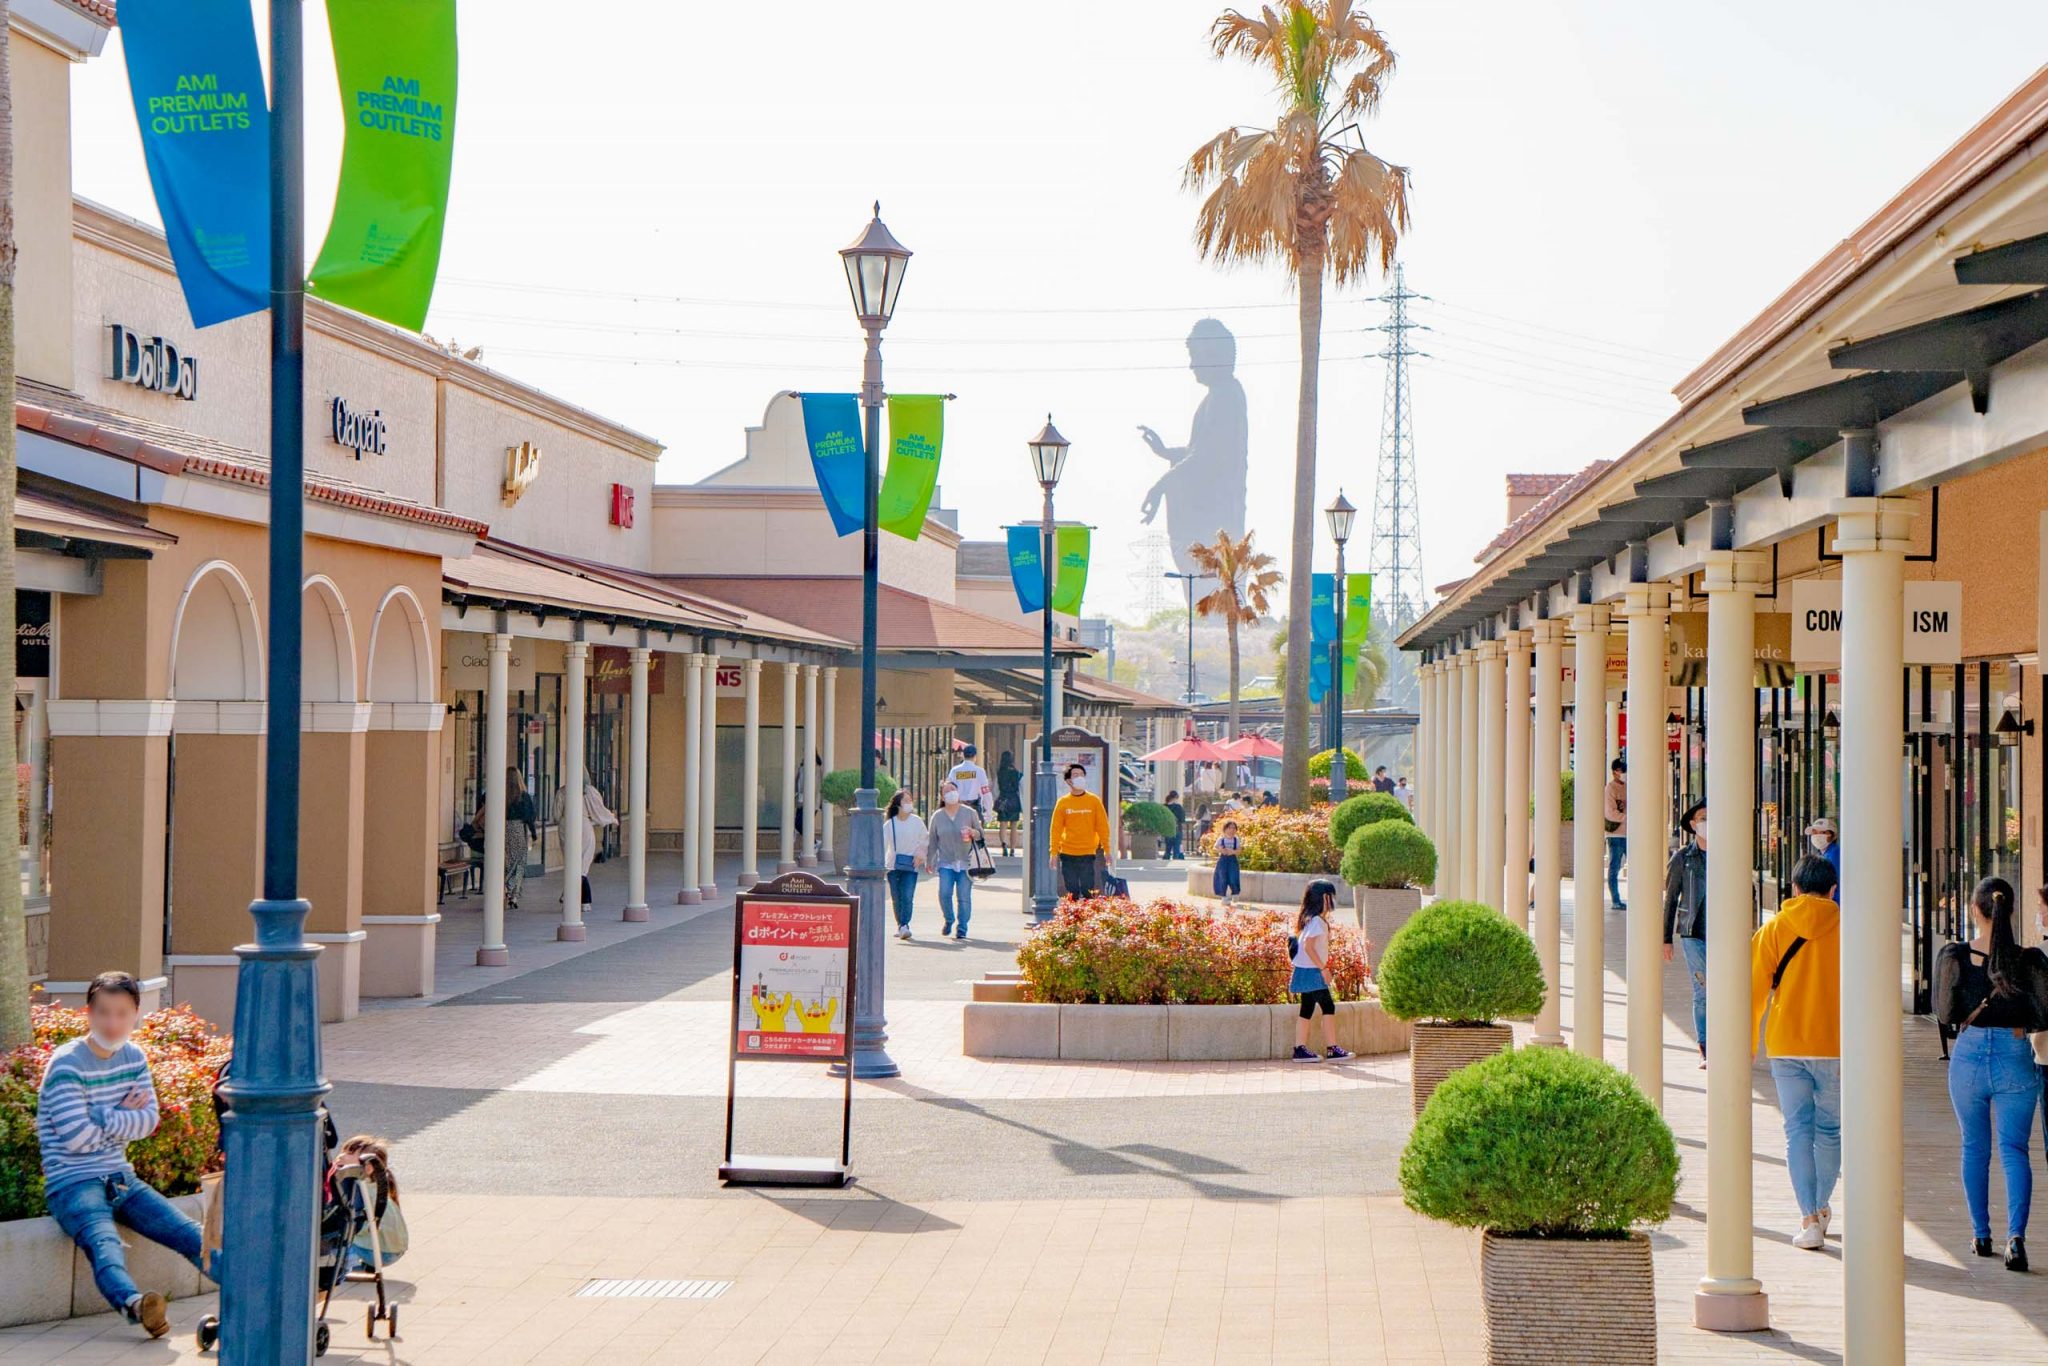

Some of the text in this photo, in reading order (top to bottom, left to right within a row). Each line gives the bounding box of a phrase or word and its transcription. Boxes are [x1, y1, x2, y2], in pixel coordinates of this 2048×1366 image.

[176, 74, 218, 92] AMI
[383, 76, 419, 96] AMI
[148, 93, 248, 114] PREMIUM
[357, 91, 442, 122] PREMIUM
[151, 112, 250, 134] OUTLETS
[359, 110, 442, 141] OUTLETS
[815, 437, 855, 449] PREMIUM
[825, 431, 843, 440] AMI
[908, 433, 925, 442] AMI
[816, 445, 856, 458] OUTLETS
[896, 439, 935, 452] PREMIUM
[896, 447, 935, 460] OUTLETS
[1806, 609, 1948, 632] COM ISM
[1684, 643, 1708, 658] ka
[716, 671, 742, 687] NS
